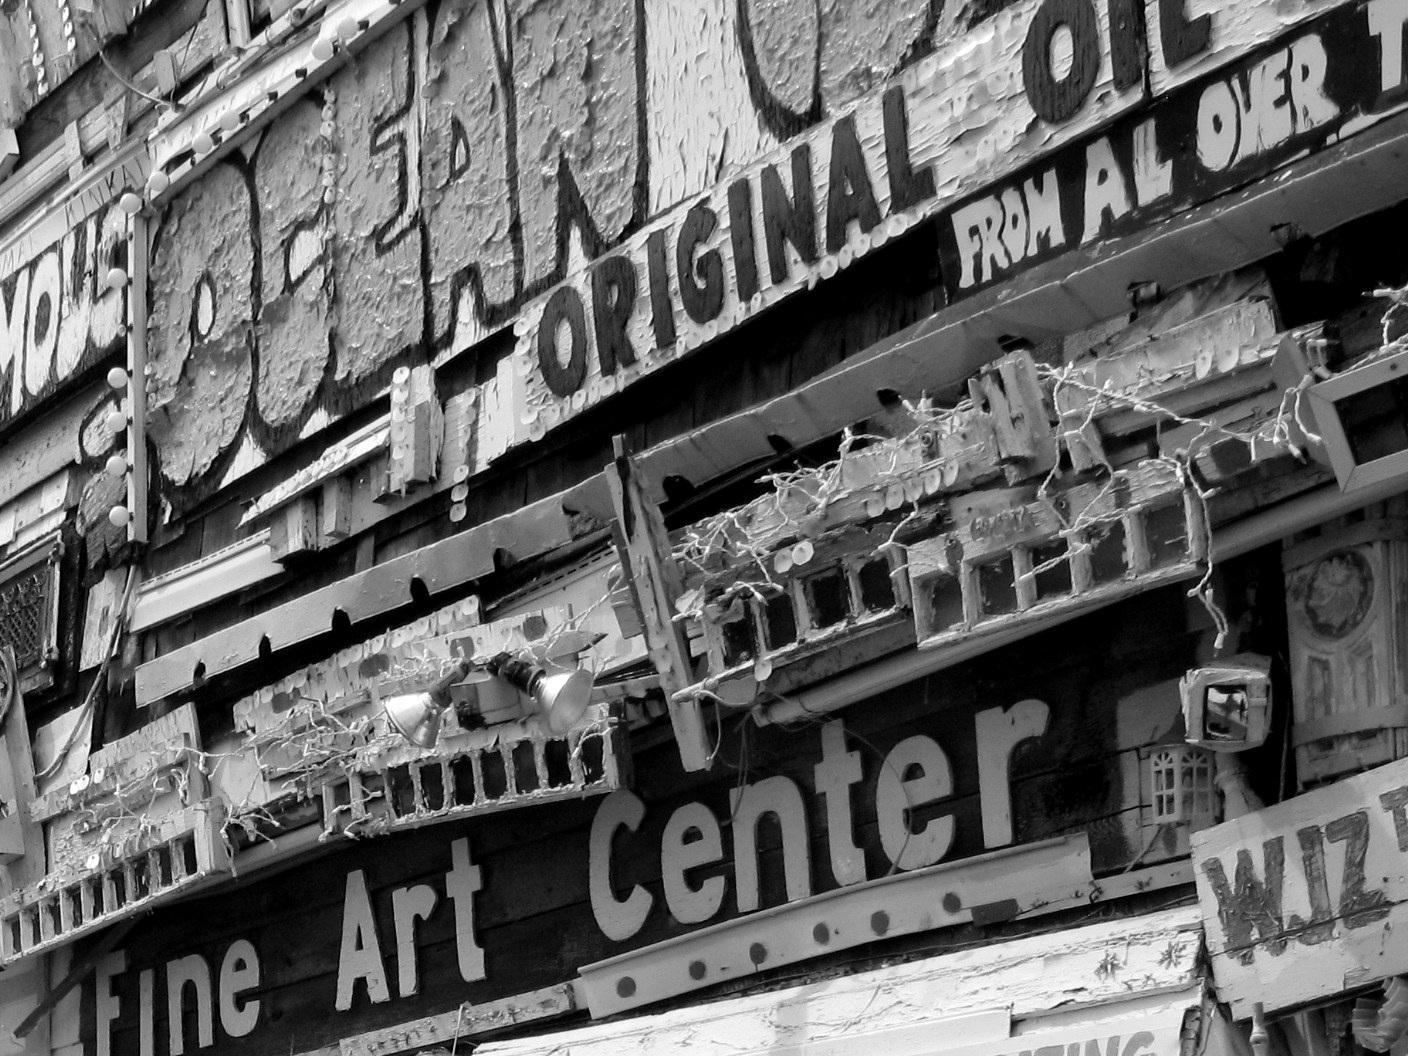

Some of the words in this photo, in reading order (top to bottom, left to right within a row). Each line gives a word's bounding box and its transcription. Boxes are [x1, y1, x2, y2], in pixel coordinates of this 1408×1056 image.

[536, 84, 936, 398] ORIGINAL
[950, 168, 1066, 289] FROM
[1194, 33, 1341, 172] OVER
[335, 837, 487, 1012] Art
[589, 698, 1051, 942] Center
